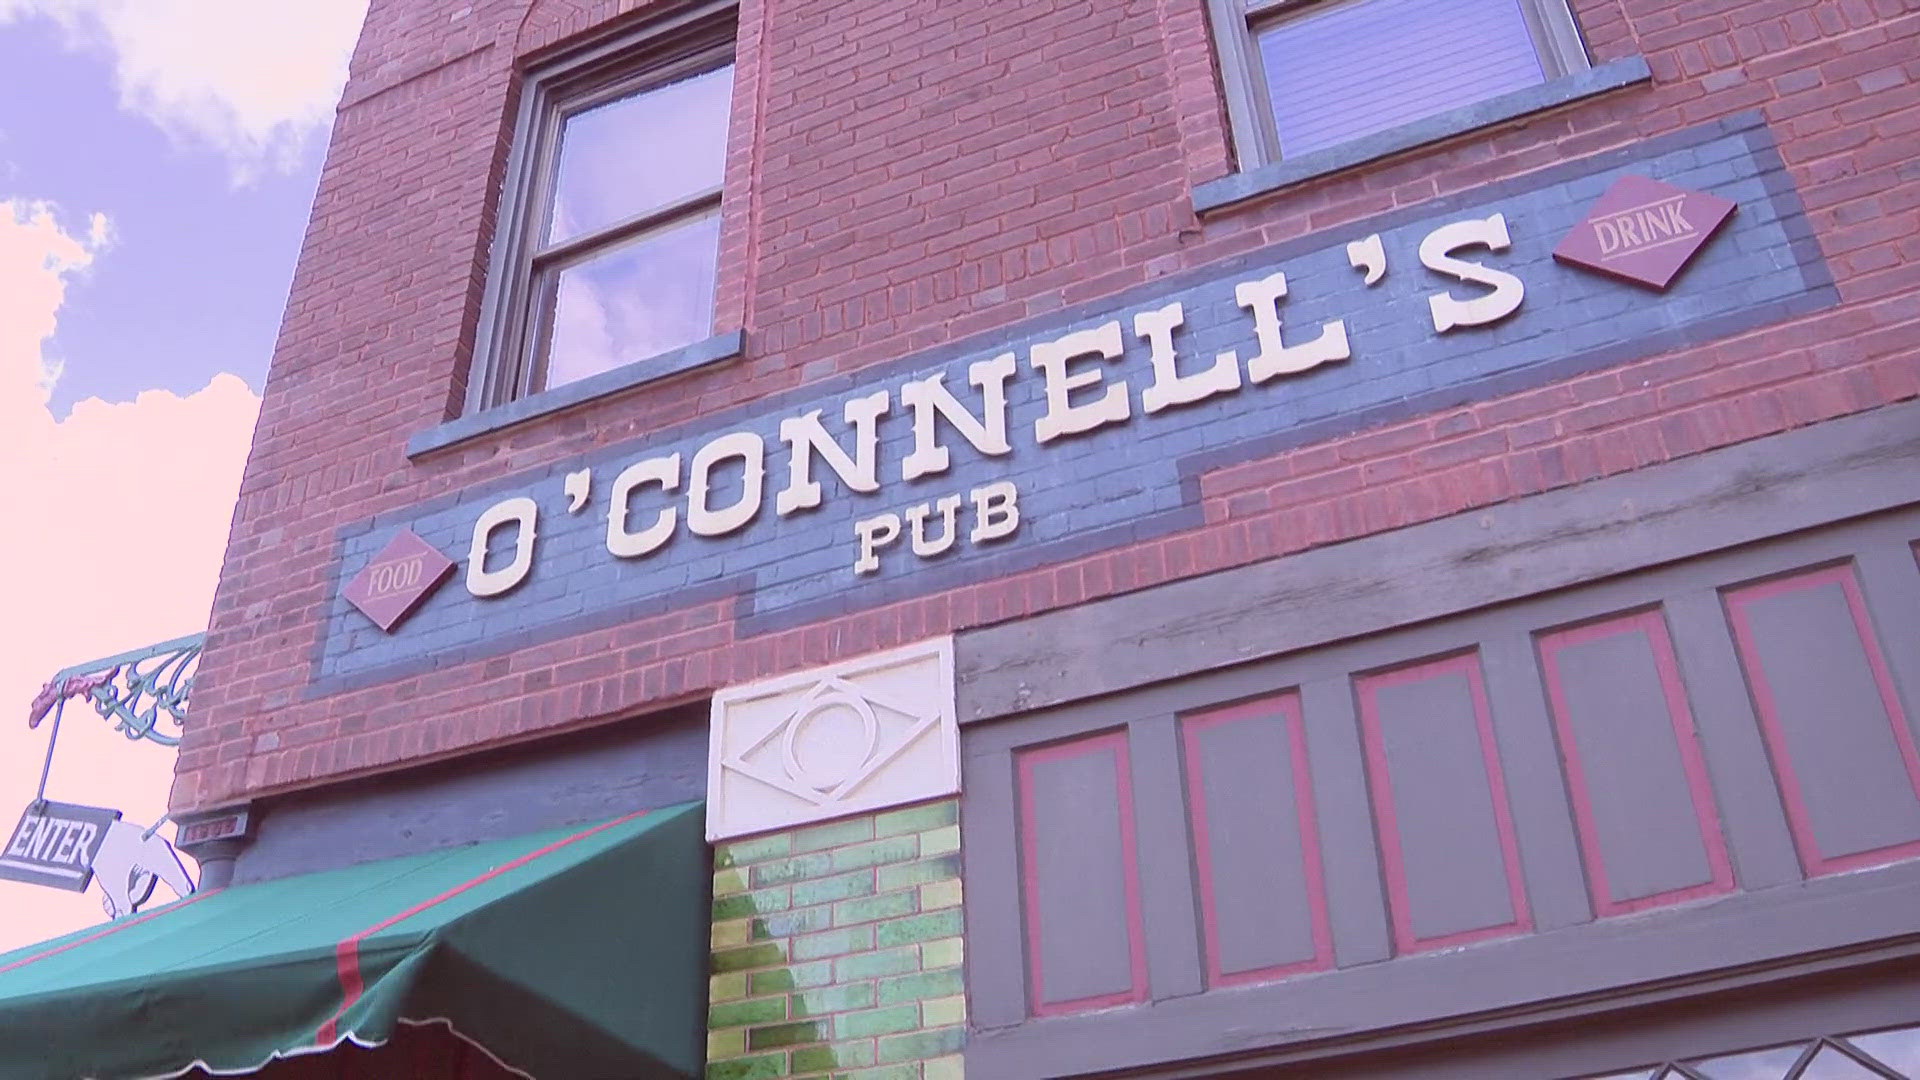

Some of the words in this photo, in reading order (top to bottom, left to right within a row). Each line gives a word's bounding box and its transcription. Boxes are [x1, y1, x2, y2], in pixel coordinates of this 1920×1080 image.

[1594, 200, 1694, 254] DRINK
[854, 481, 1020, 576] PUB
[367, 559, 424, 597] FOOD
[8, 815, 98, 868] ENTER
